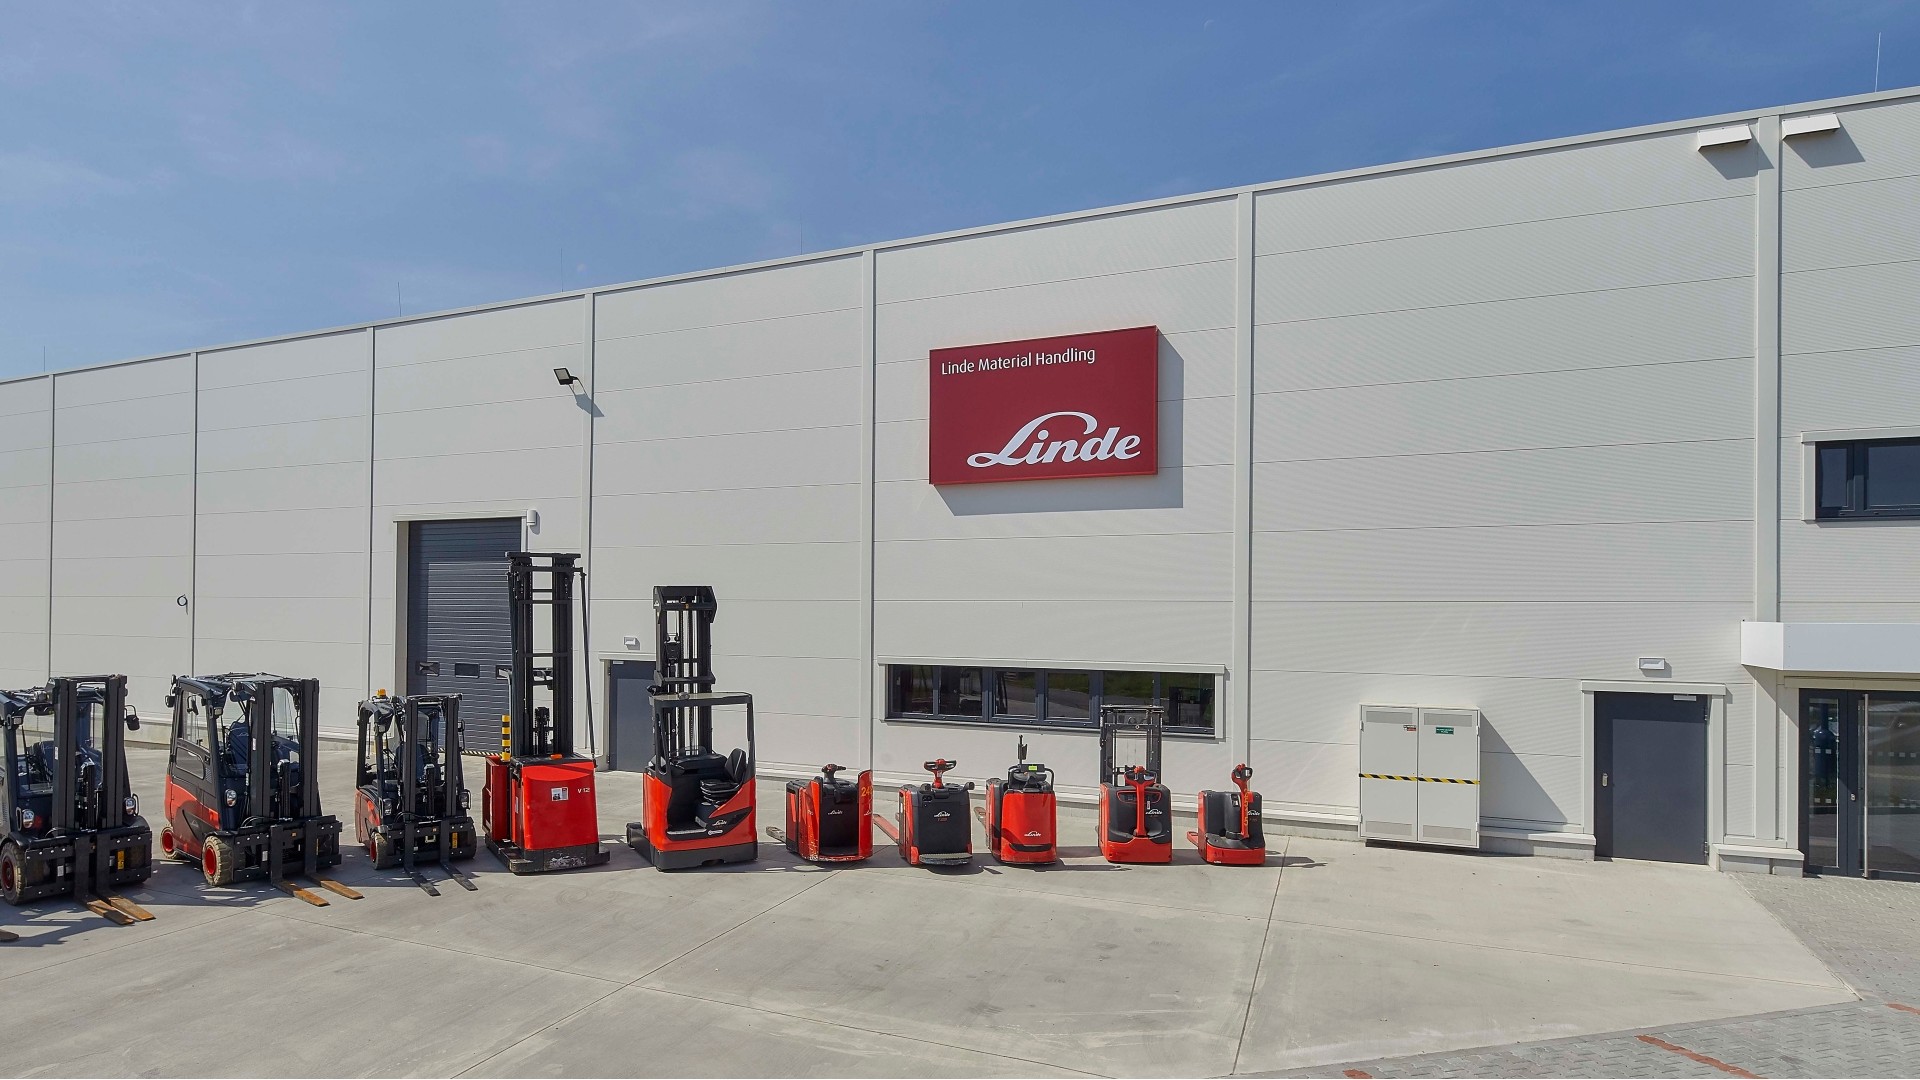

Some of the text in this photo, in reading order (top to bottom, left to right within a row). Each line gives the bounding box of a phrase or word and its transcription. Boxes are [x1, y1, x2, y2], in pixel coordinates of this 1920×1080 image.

[941, 347, 1096, 375] Linde Material Handling
[966, 411, 1141, 468] Linde
